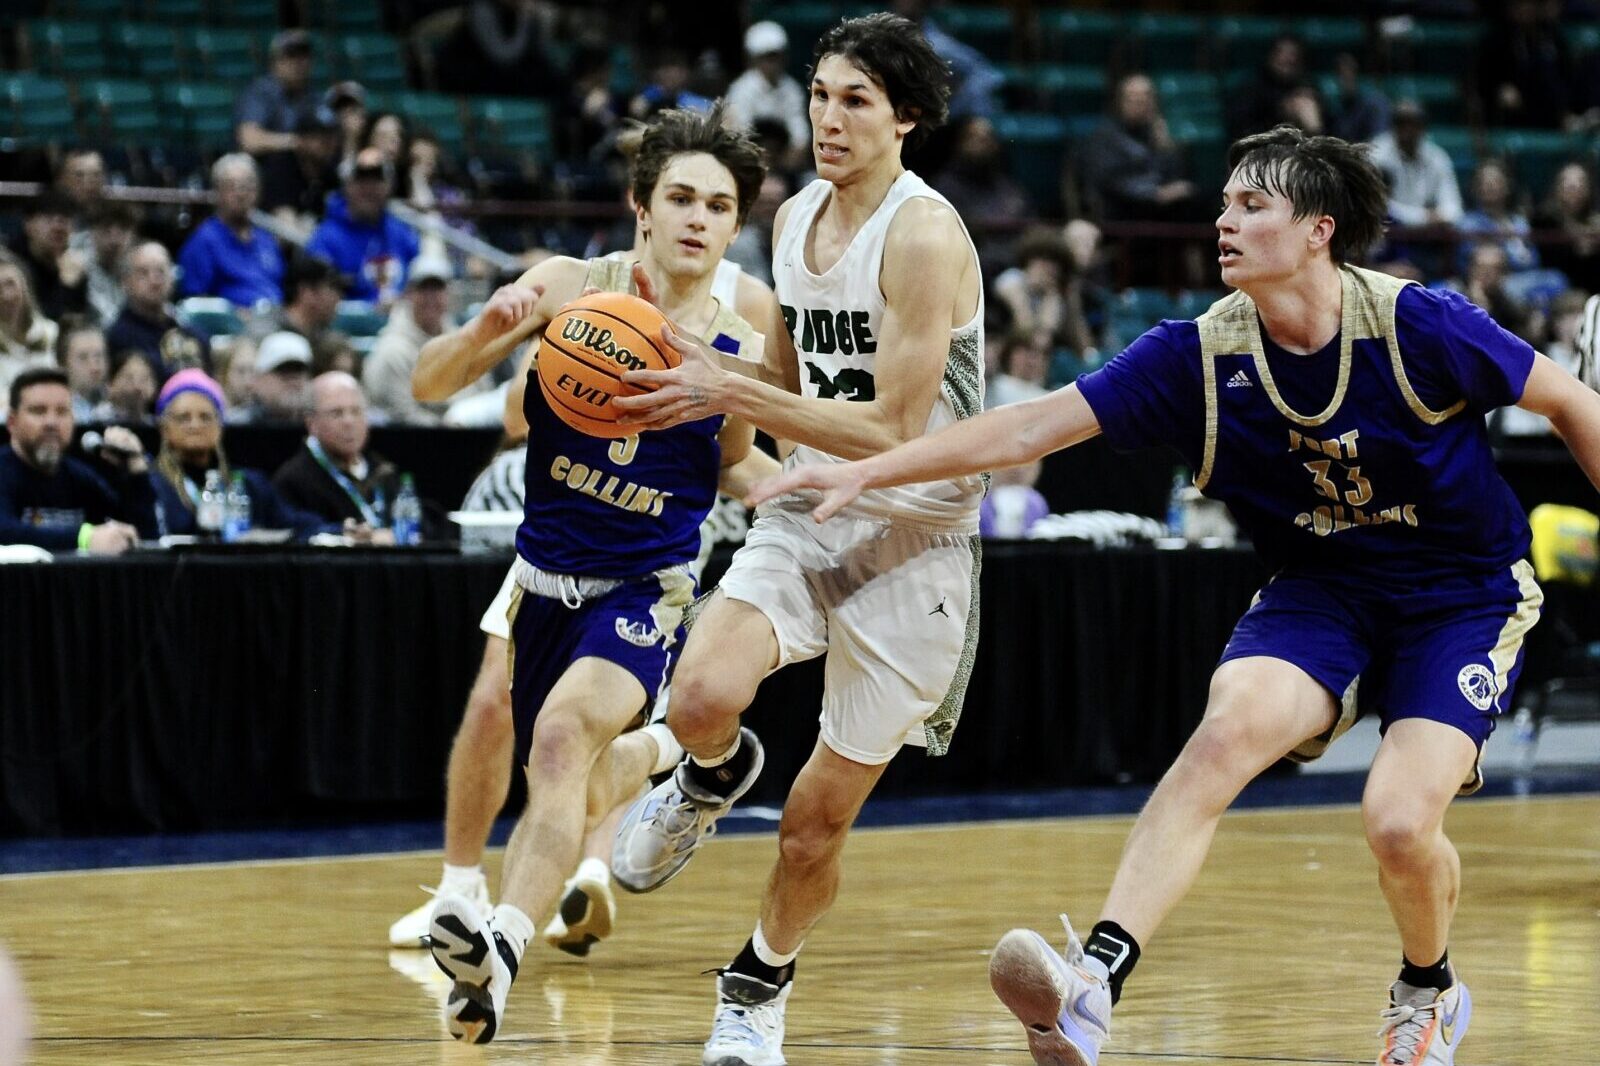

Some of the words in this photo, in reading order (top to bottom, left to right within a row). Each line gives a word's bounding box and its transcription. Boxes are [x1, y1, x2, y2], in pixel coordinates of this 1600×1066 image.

[562, 317, 647, 371] Wilson
[550, 455, 674, 517] COLLINS
[1303, 459, 1374, 506] 33
